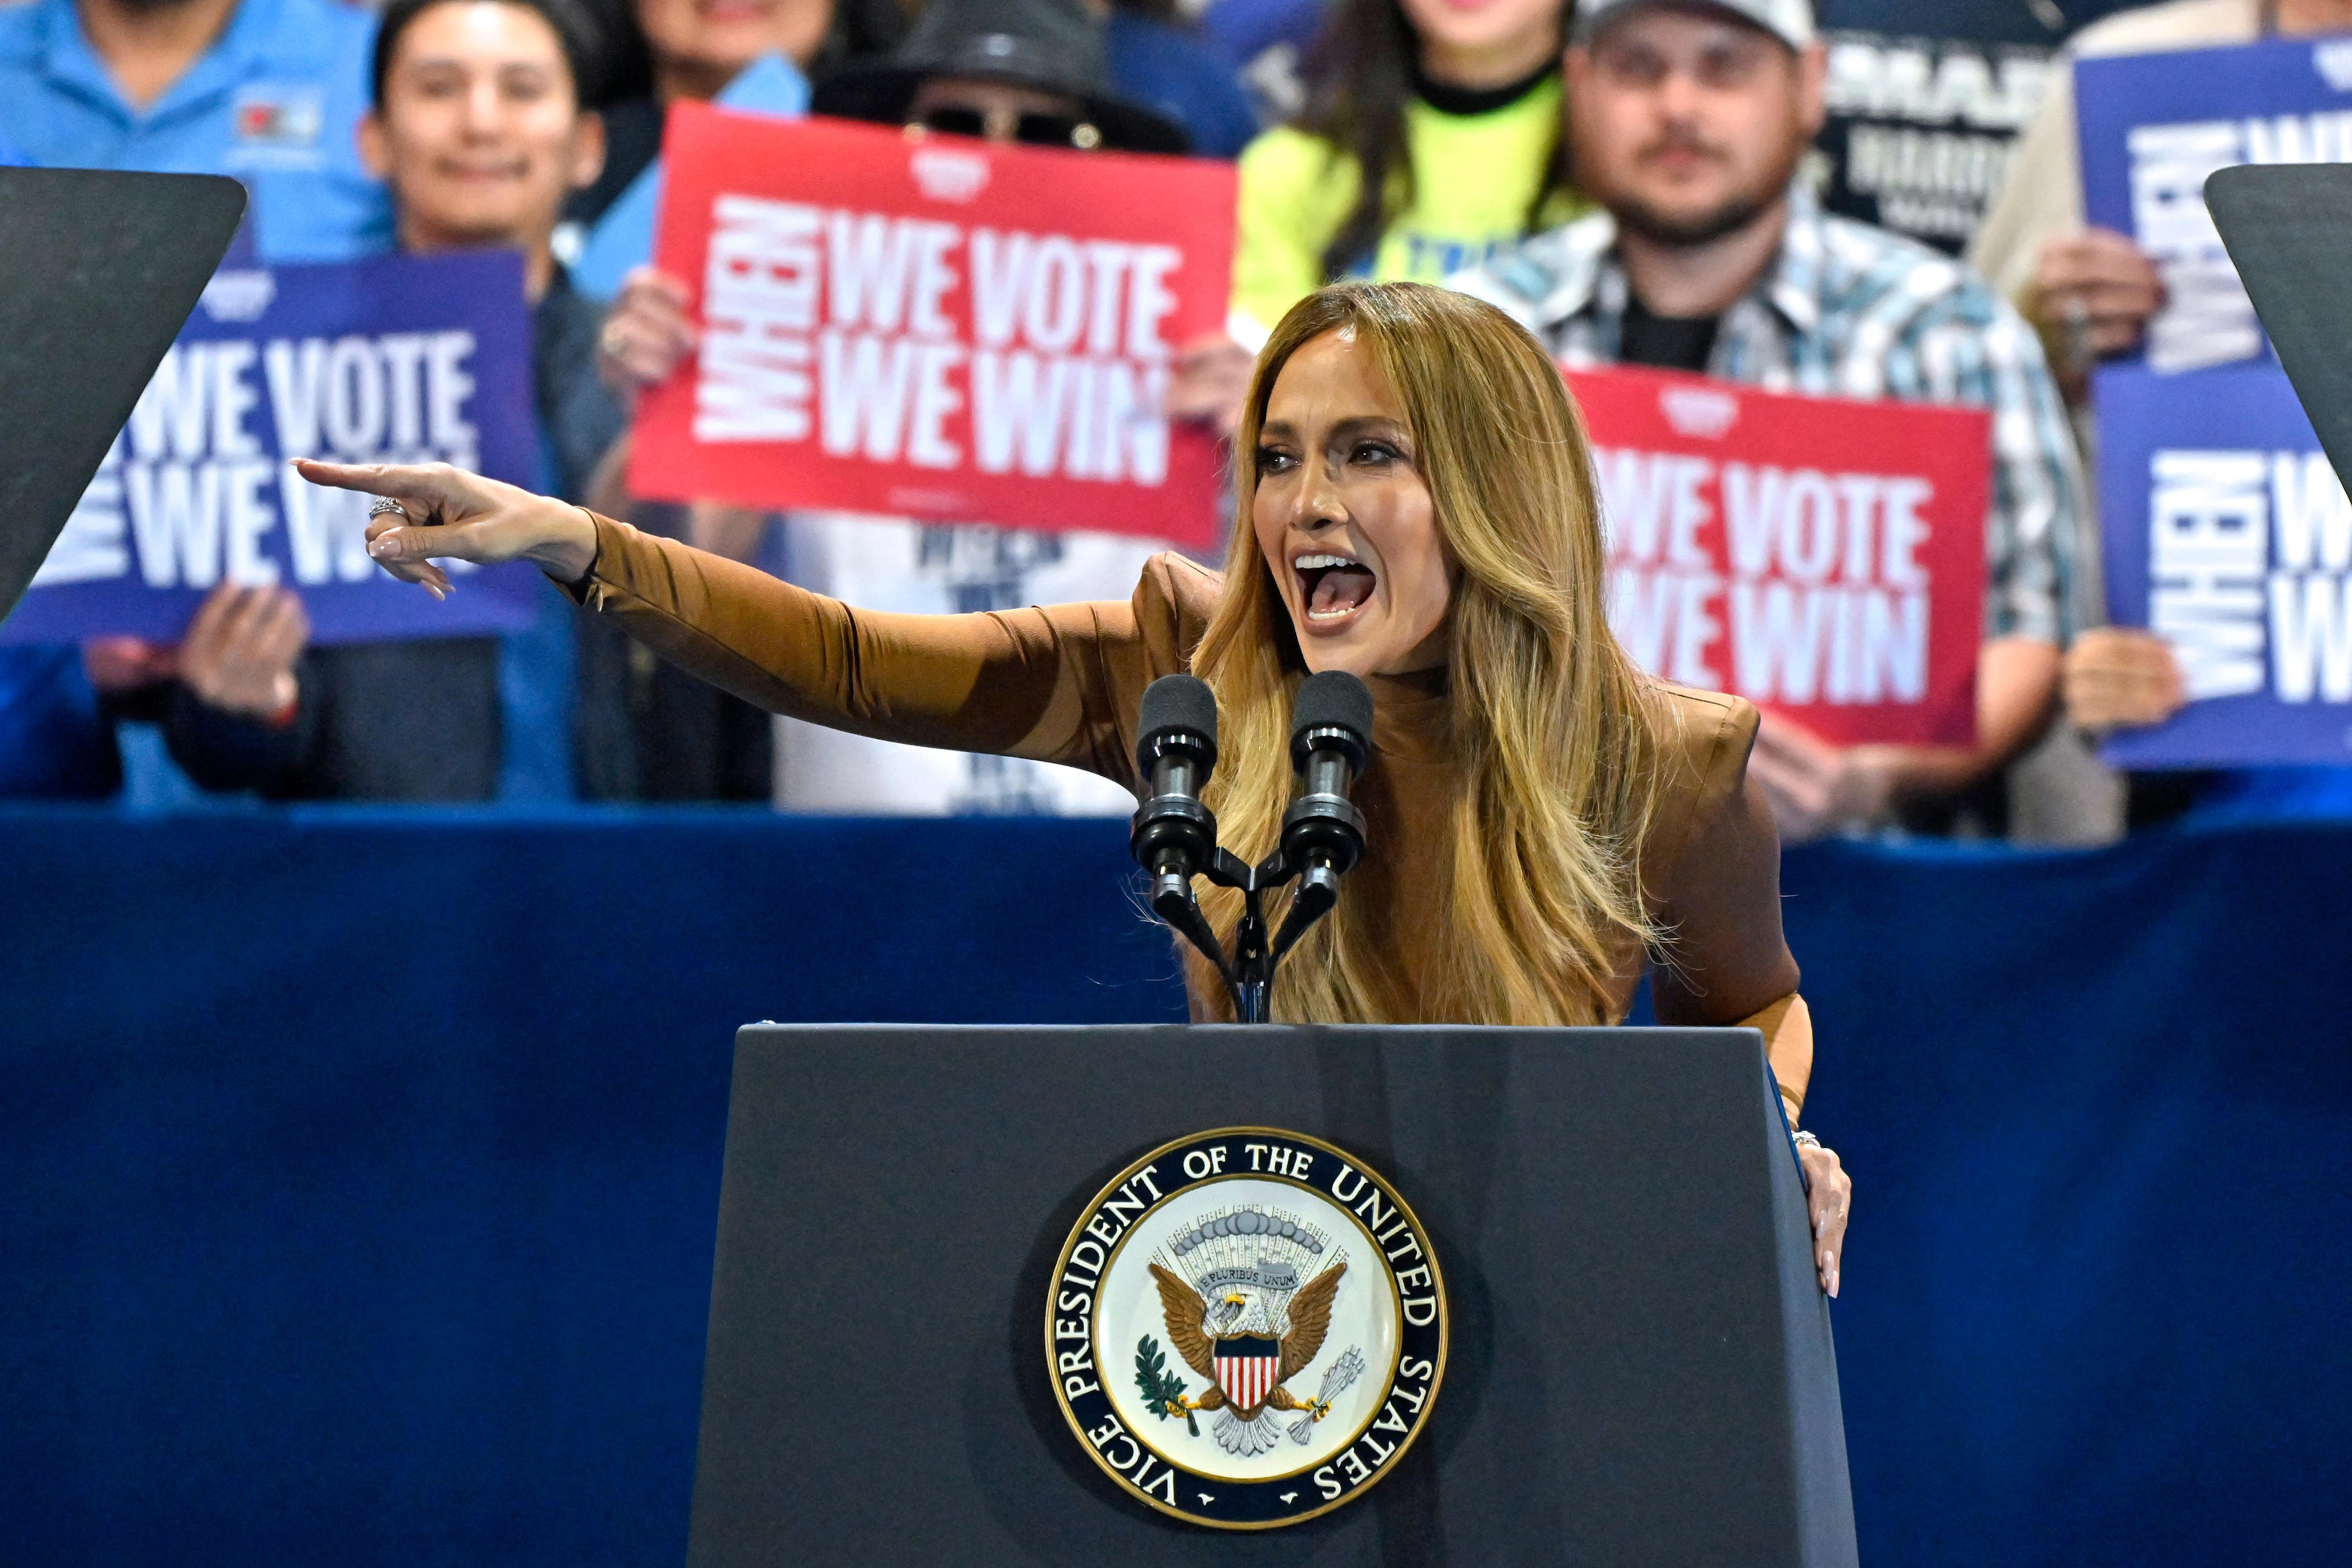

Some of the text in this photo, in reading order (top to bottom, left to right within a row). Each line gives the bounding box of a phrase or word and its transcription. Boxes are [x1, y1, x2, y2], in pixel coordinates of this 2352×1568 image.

[692, 192, 824, 443] WHEN
[823, 209, 1184, 361] WE VOTE
[129, 330, 479, 461] WE VOTE
[818, 325, 1170, 487] WE WIN
[126, 454, 280, 587] WE
[1722, 457, 1934, 588] VOTE
[1729, 578, 1932, 707] WIN
[1056, 1144, 1437, 1507] VICE PRESIDENT OF THE UNITED STATES
[1200, 1270, 1296, 1287] E PLURIBUS UNUM
